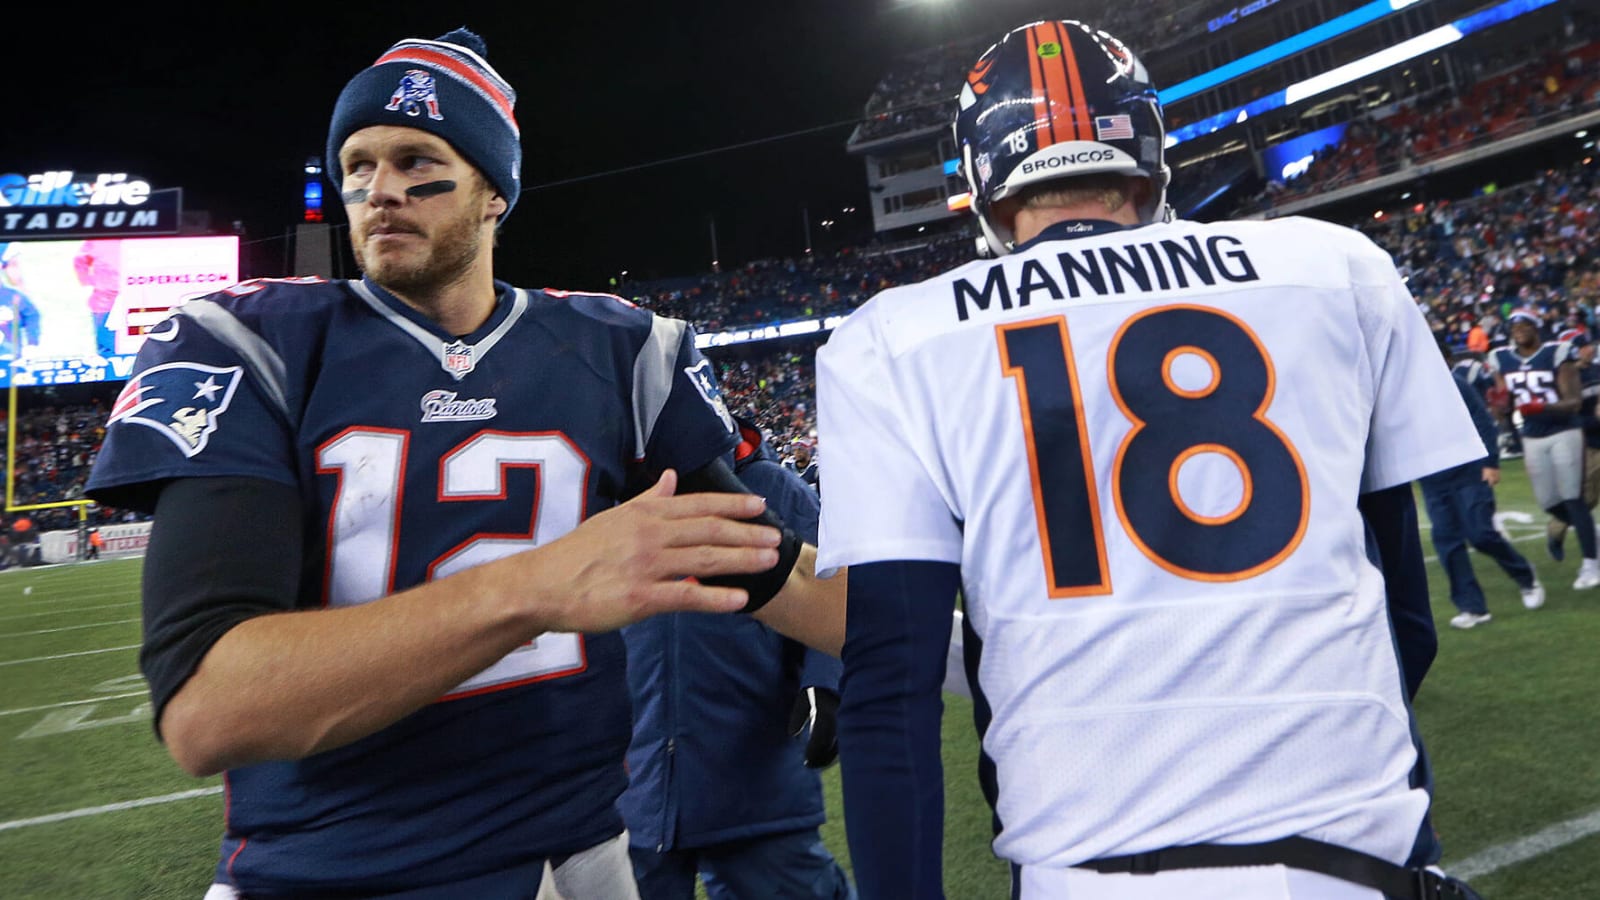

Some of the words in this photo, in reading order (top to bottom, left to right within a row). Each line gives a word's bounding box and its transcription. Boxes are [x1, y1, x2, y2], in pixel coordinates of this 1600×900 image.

[1007, 129, 1029, 154] 18
[1022, 149, 1115, 174] BRONCOS
[4, 210, 158, 230] TADIUM
[952, 235, 1260, 321] MANNING
[447, 354, 472, 370] NFL
[1504, 370, 1559, 405] 55
[420, 389, 498, 423] Patriots
[994, 303, 1311, 599] 18
[315, 425, 592, 702] 12
